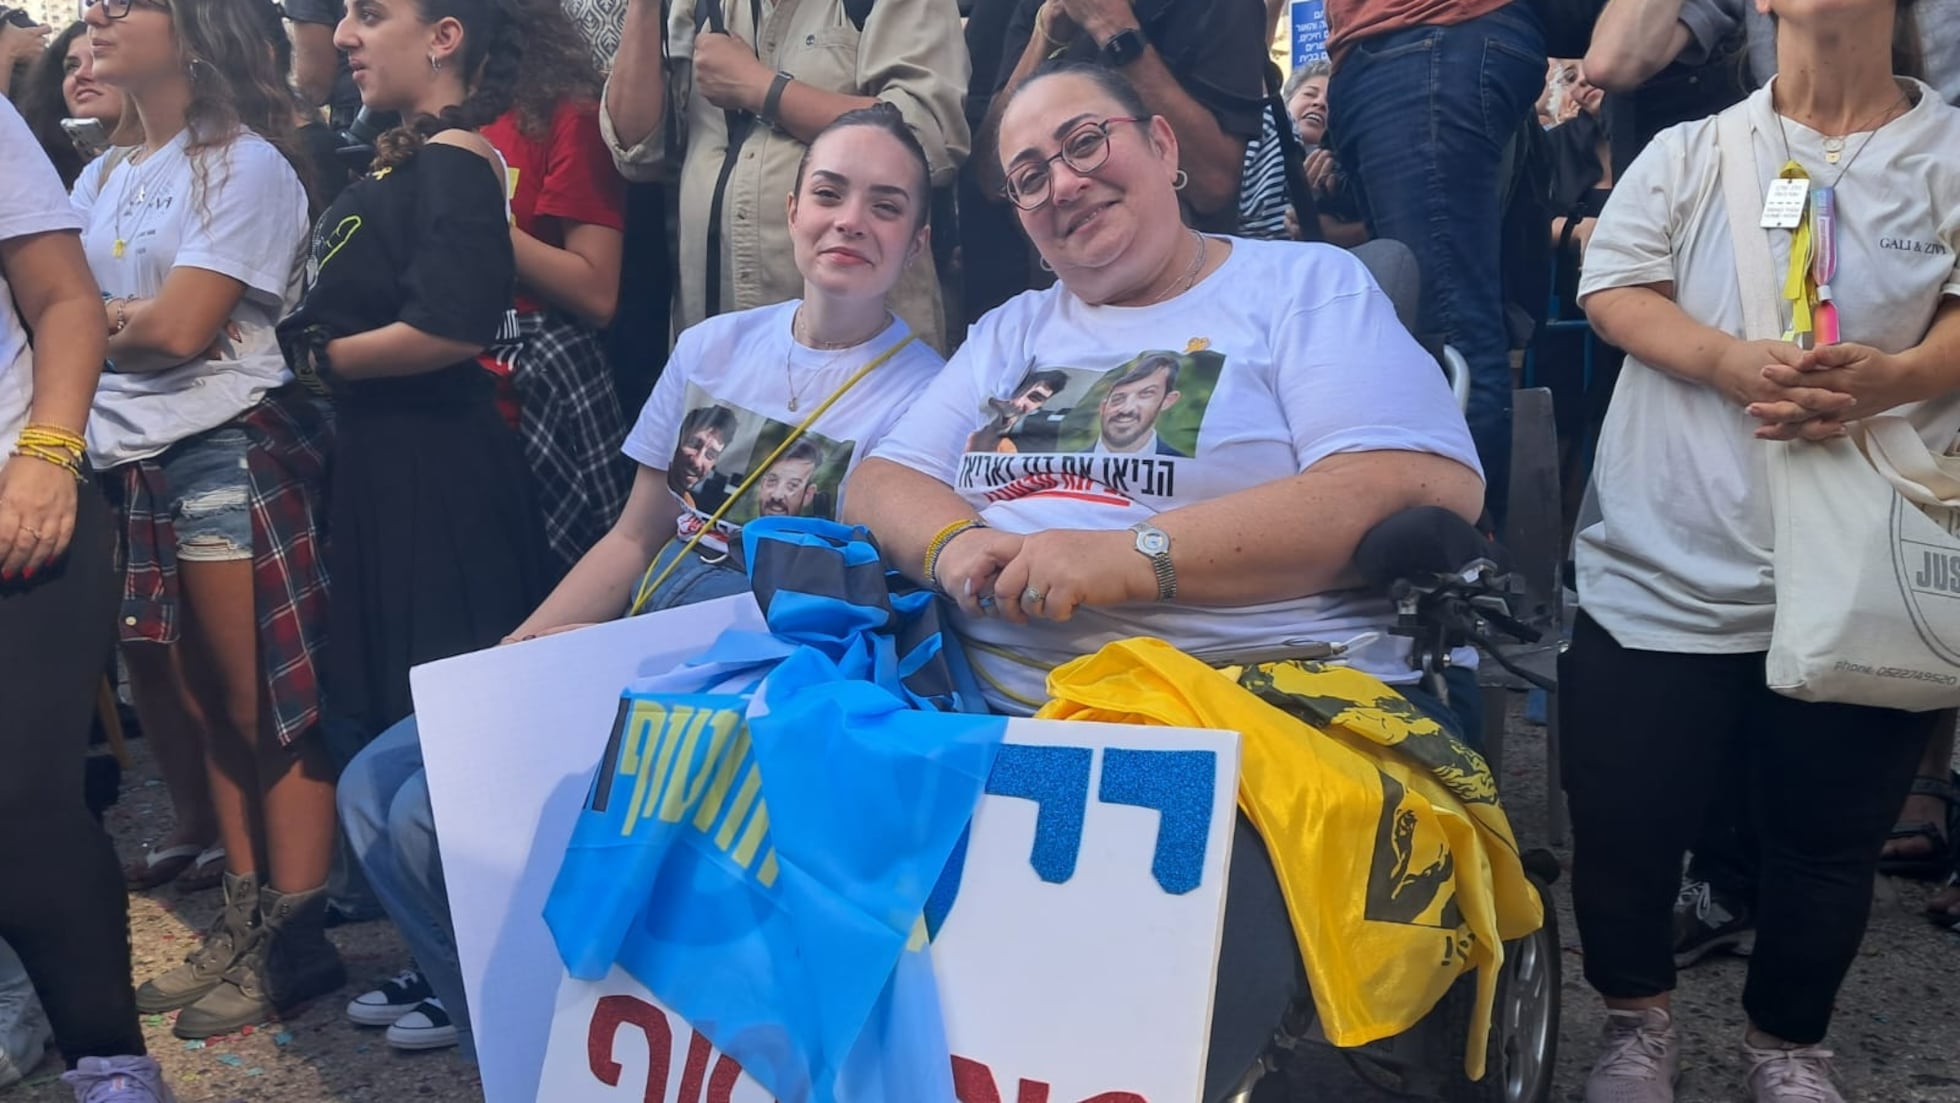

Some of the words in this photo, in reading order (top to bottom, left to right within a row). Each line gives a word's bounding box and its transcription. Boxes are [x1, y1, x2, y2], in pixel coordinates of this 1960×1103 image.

[1880, 239, 1911, 251] GALI
[1914, 241, 1921, 252] &
[1062, 455, 1095, 477] את
[1103, 456, 1175, 496] הביאו
